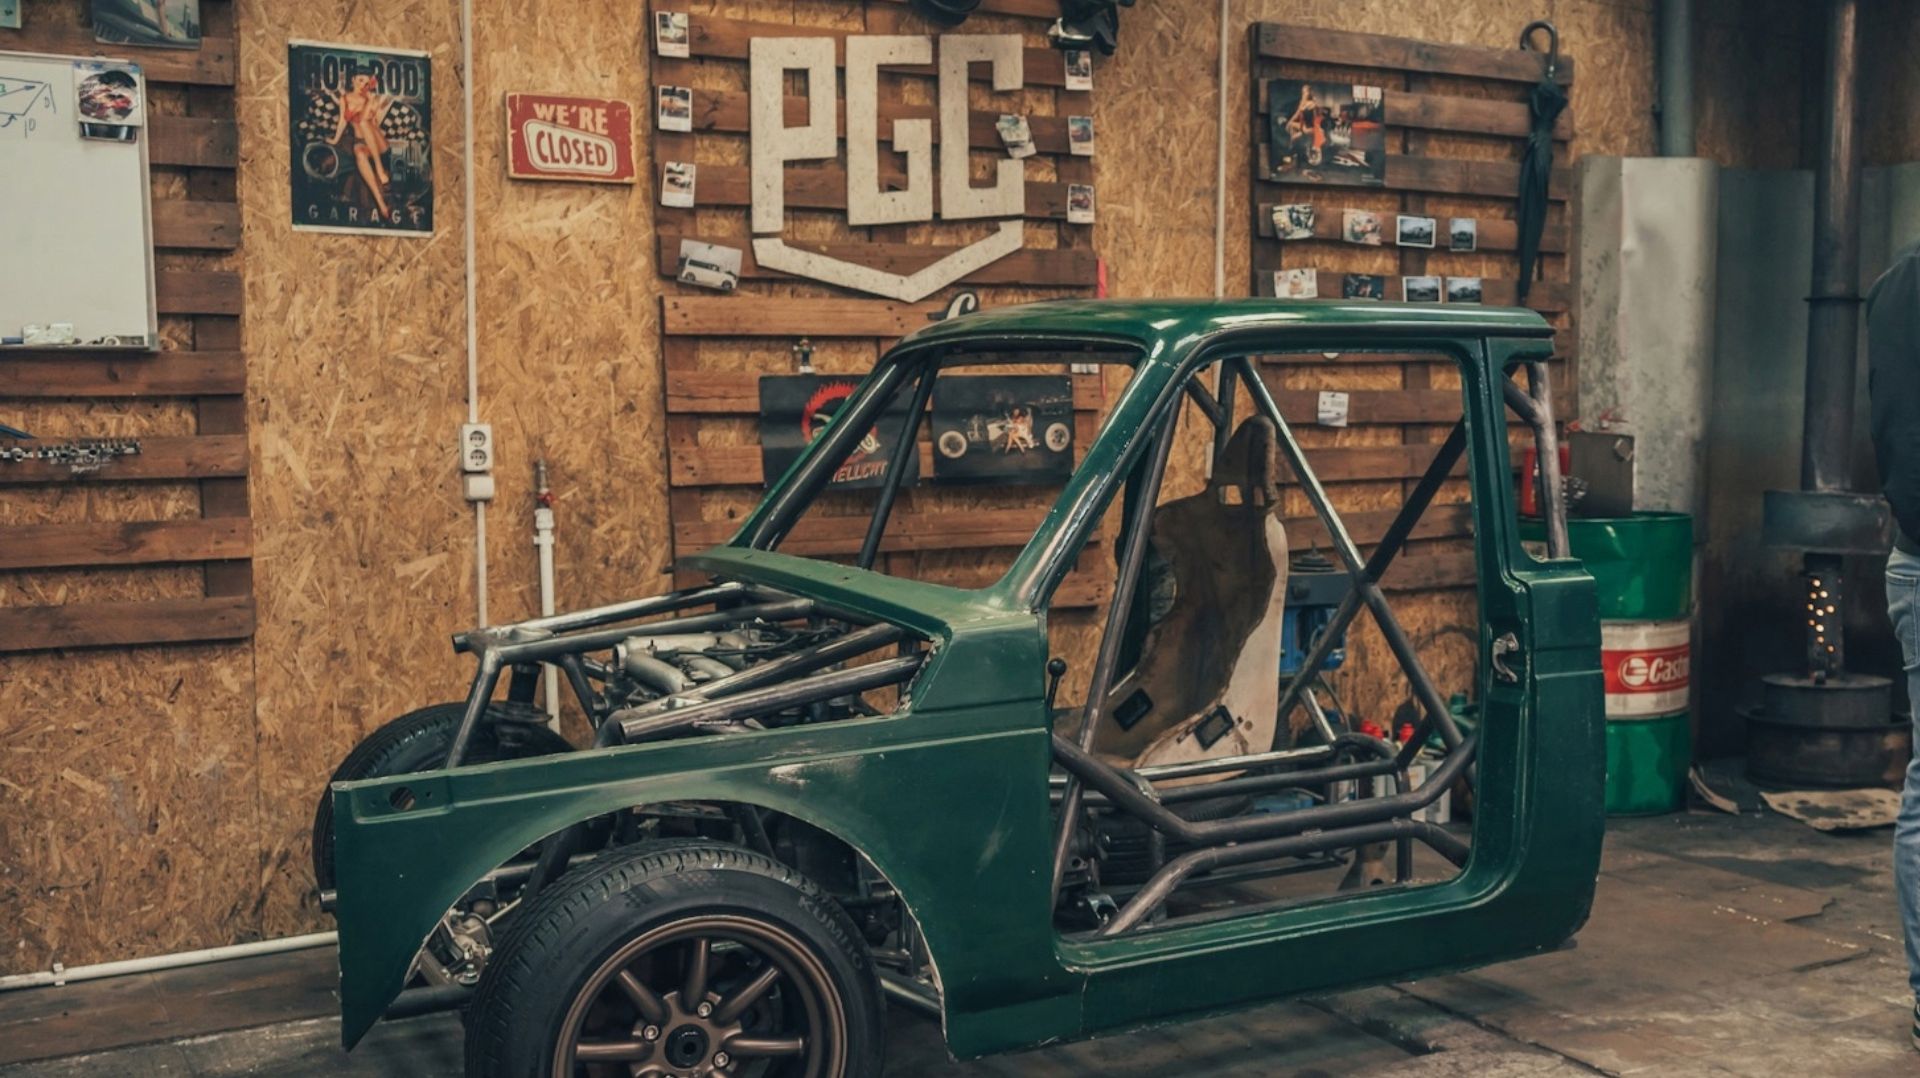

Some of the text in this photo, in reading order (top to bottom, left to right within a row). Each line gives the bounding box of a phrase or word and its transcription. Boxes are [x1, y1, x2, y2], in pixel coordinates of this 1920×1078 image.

[304, 53, 419, 97] HOT ROD
[532, 102, 609, 136] WE'RE
[750, 34, 1024, 233] PGC
[535, 130, 608, 168] CLOSED
[308, 204, 422, 225] GARAGE
